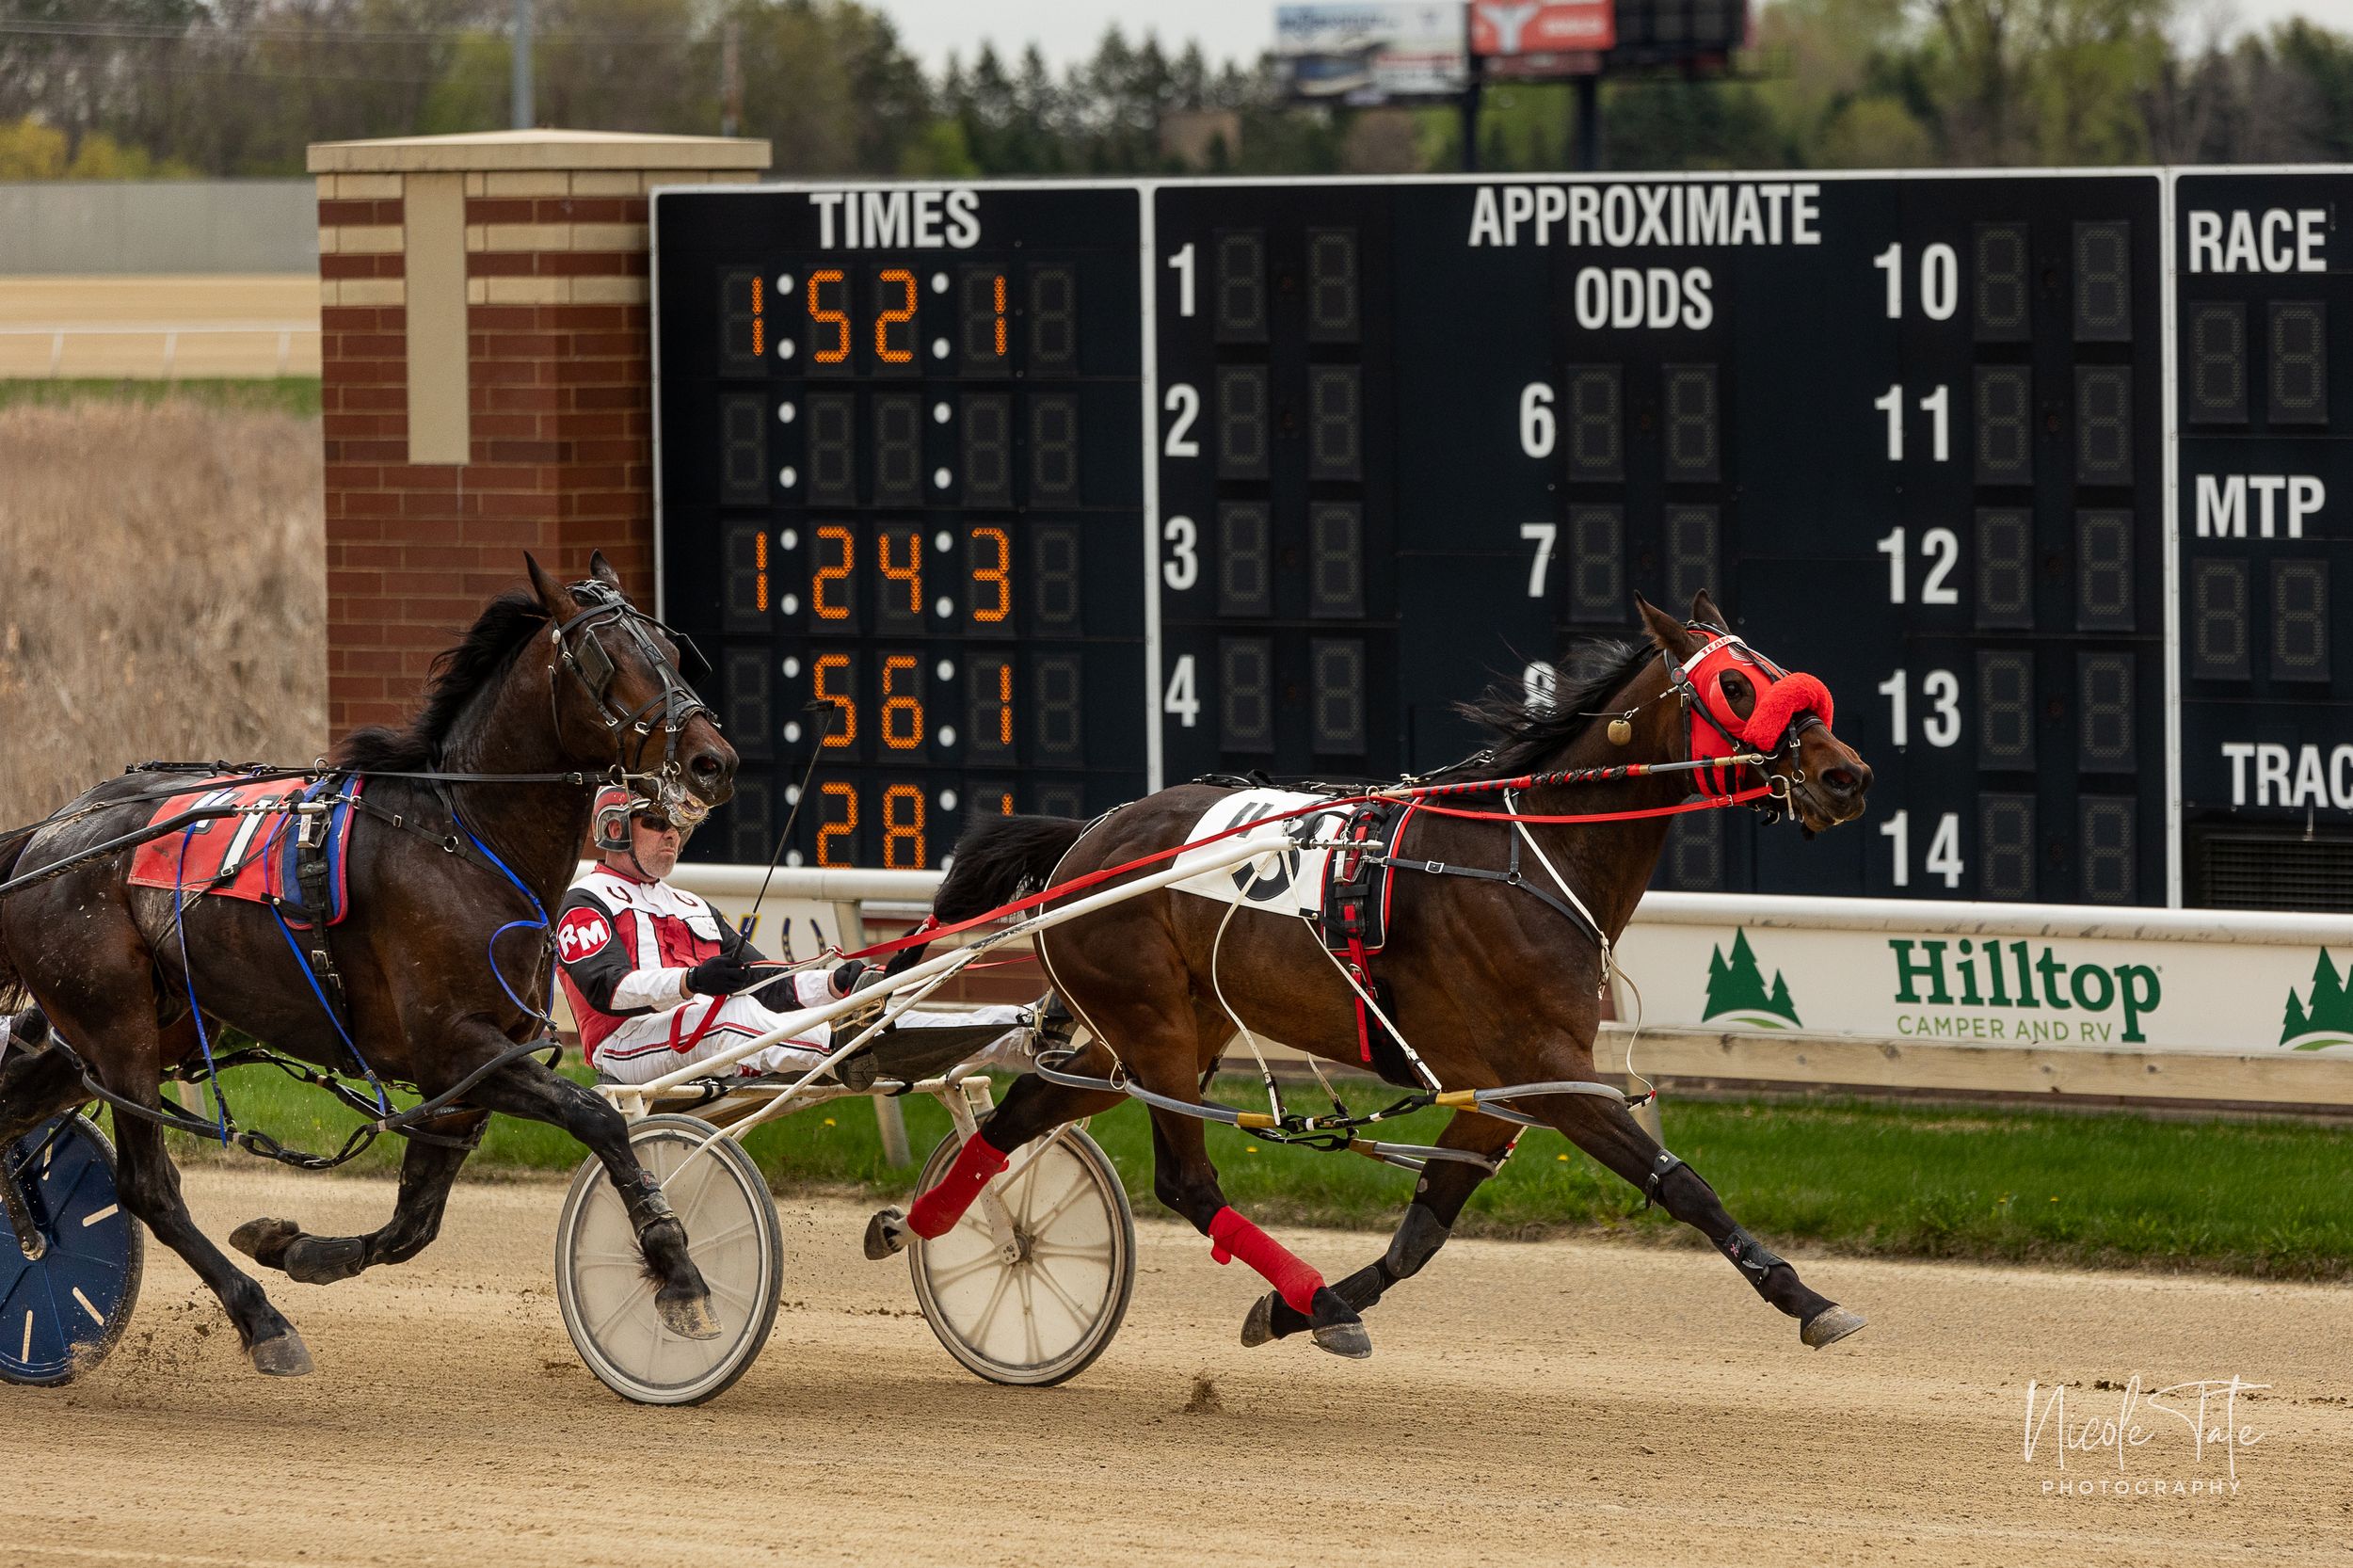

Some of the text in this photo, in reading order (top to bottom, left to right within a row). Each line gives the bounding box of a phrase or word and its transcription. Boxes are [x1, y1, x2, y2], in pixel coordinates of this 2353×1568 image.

[809, 191, 981, 248] TIMES
[1468, 184, 1821, 247] APPROXIMATE
[2188, 209, 2327, 273] RACE
[1168, 243, 1195, 317] 1
[1575, 267, 1713, 329] ODDS
[1873, 242, 1958, 320] 10
[1164, 384, 1200, 457] 2
[1519, 382, 1556, 458] 6
[1874, 384, 1948, 461] 11
[2196, 475, 2326, 538] MTP
[1163, 516, 1198, 590] 3
[1520, 523, 1557, 598] 7
[1877, 527, 1959, 604] 12
[1164, 654, 1200, 728] 4
[1879, 669, 1961, 747] 13
[2221, 744, 2353, 810] TRAC
[1880, 810, 1964, 888] 14
[558, 919, 608, 957] RM
[1888, 938, 2162, 1043] Hilltop
[1897, 1015, 2112, 1042] CAMPER AND RV
